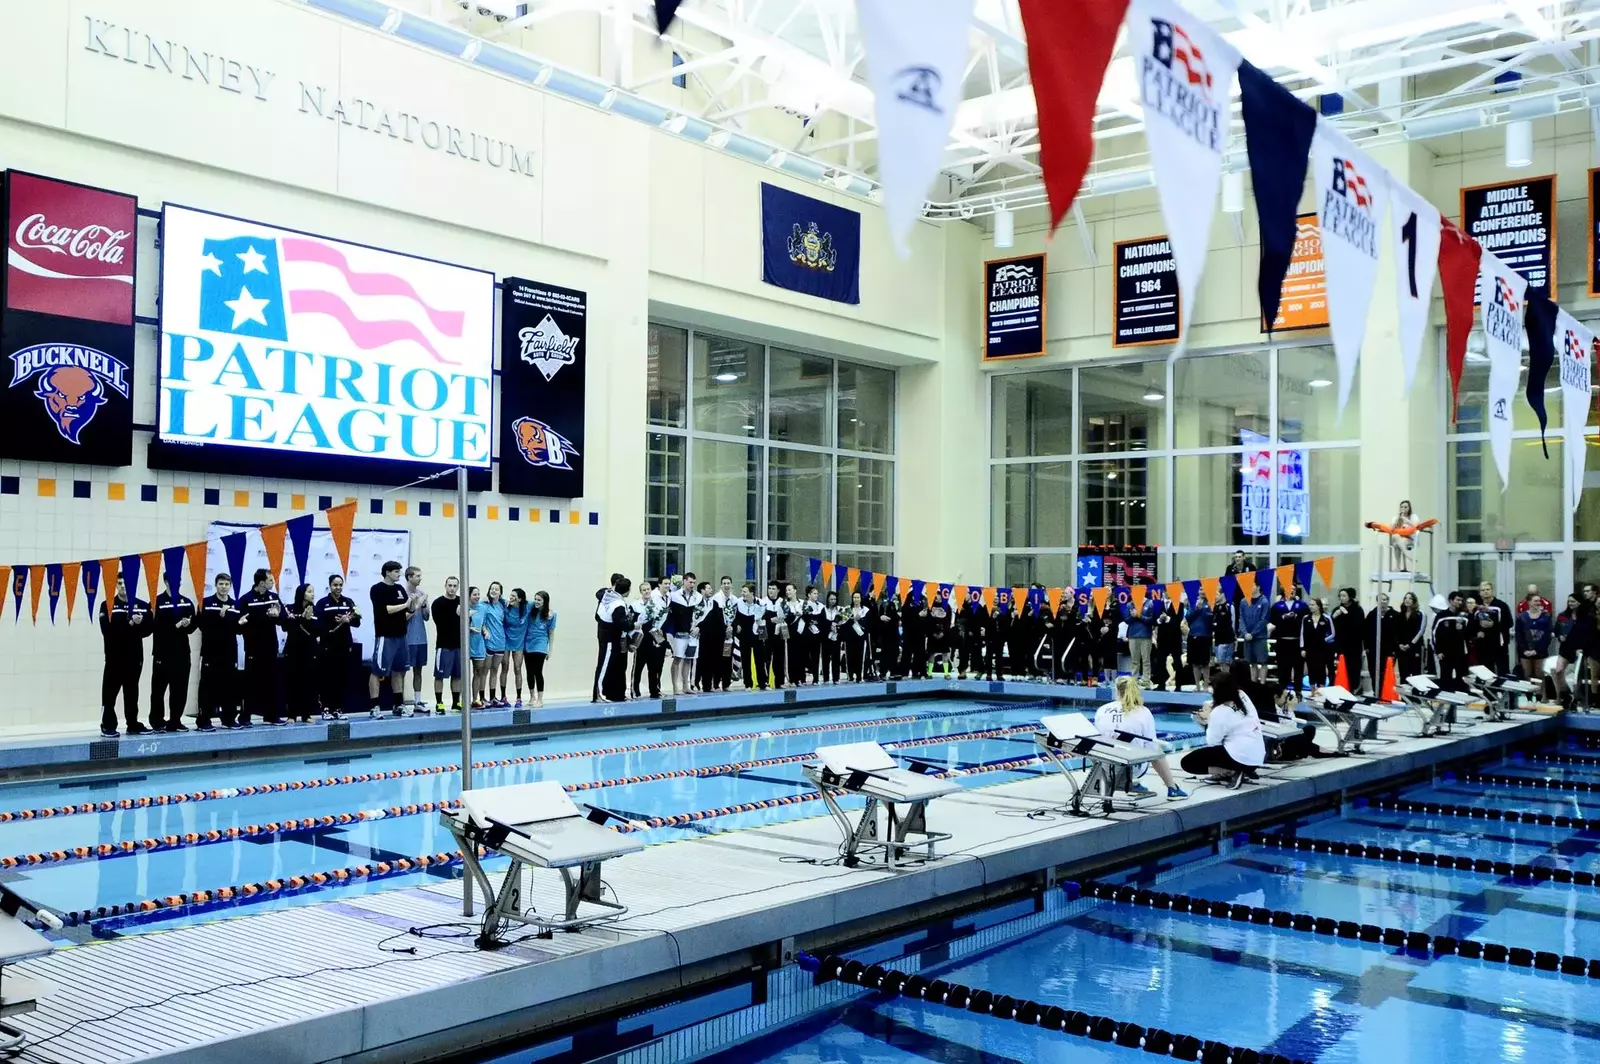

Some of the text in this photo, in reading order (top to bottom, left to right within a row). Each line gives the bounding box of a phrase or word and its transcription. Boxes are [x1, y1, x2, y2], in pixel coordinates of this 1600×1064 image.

[84, 16, 535, 177] KINNEY NATATORIUM
[1486, 186, 1528, 204] MIDDLE
[1324, 189, 1377, 238] PATRIOT
[1480, 199, 1534, 219] ATLANTIC
[1472, 212, 1543, 233] CONFERENCE
[15, 213, 131, 265] Coca-Cola
[1322, 207, 1378, 260] LEAGUE
[1124, 241, 1172, 260] NATIONAL
[1120, 258, 1176, 278] CHAMPIONS
[992, 277, 1039, 291] PATRIOT
[992, 284, 1038, 298] LEAGUE
[1135, 279, 1162, 294] 1964
[989, 295, 1040, 313] CHAMPIONS
[520, 330, 577, 355] Fairfield
[16, 346, 126, 392] BUCKNELL
[161, 331, 490, 417] PATRIOT
[160, 386, 489, 463] LEAGUE
[1094, 778, 1101, 794] 4
[869, 819, 877, 838] 3
[511, 888, 520, 911] 2
